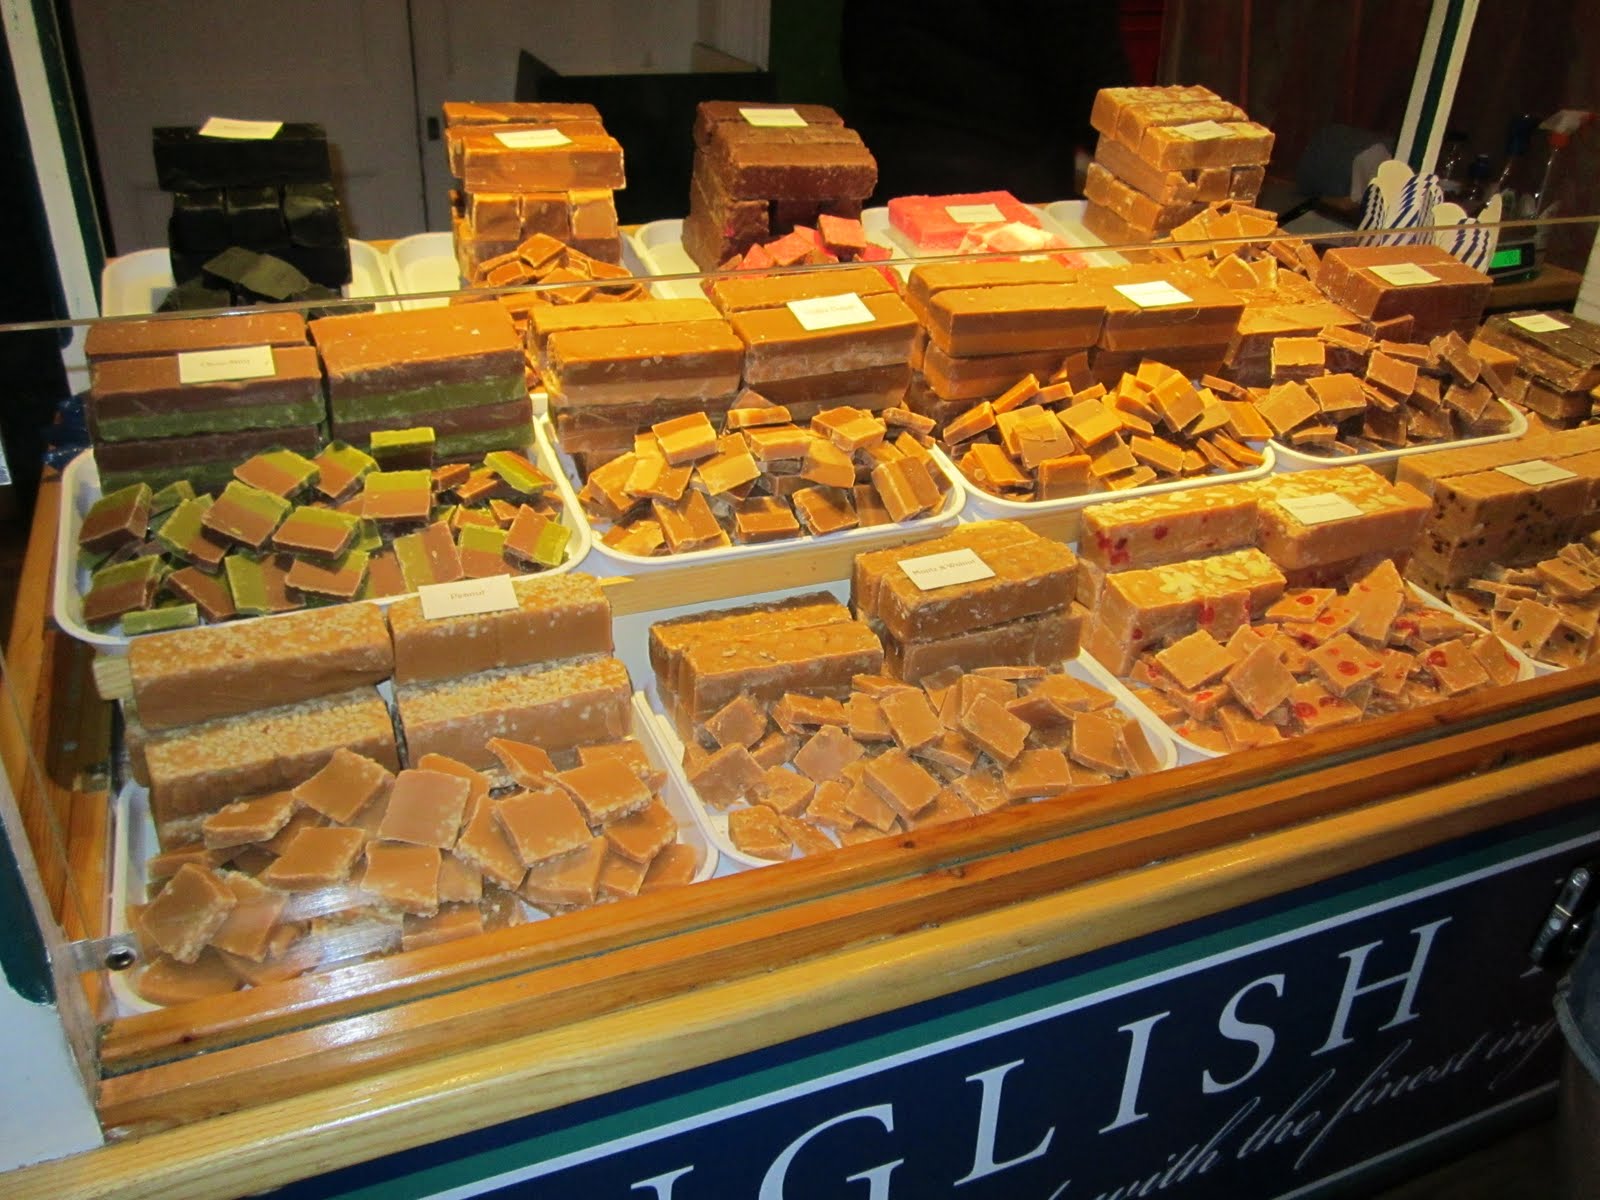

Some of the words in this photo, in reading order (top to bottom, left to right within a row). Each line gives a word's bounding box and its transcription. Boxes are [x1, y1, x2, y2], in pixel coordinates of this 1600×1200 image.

[631, 915, 1452, 1200] GLISH
[1257, 1068, 1336, 1159] the
[1293, 1038, 1489, 1171] finest
